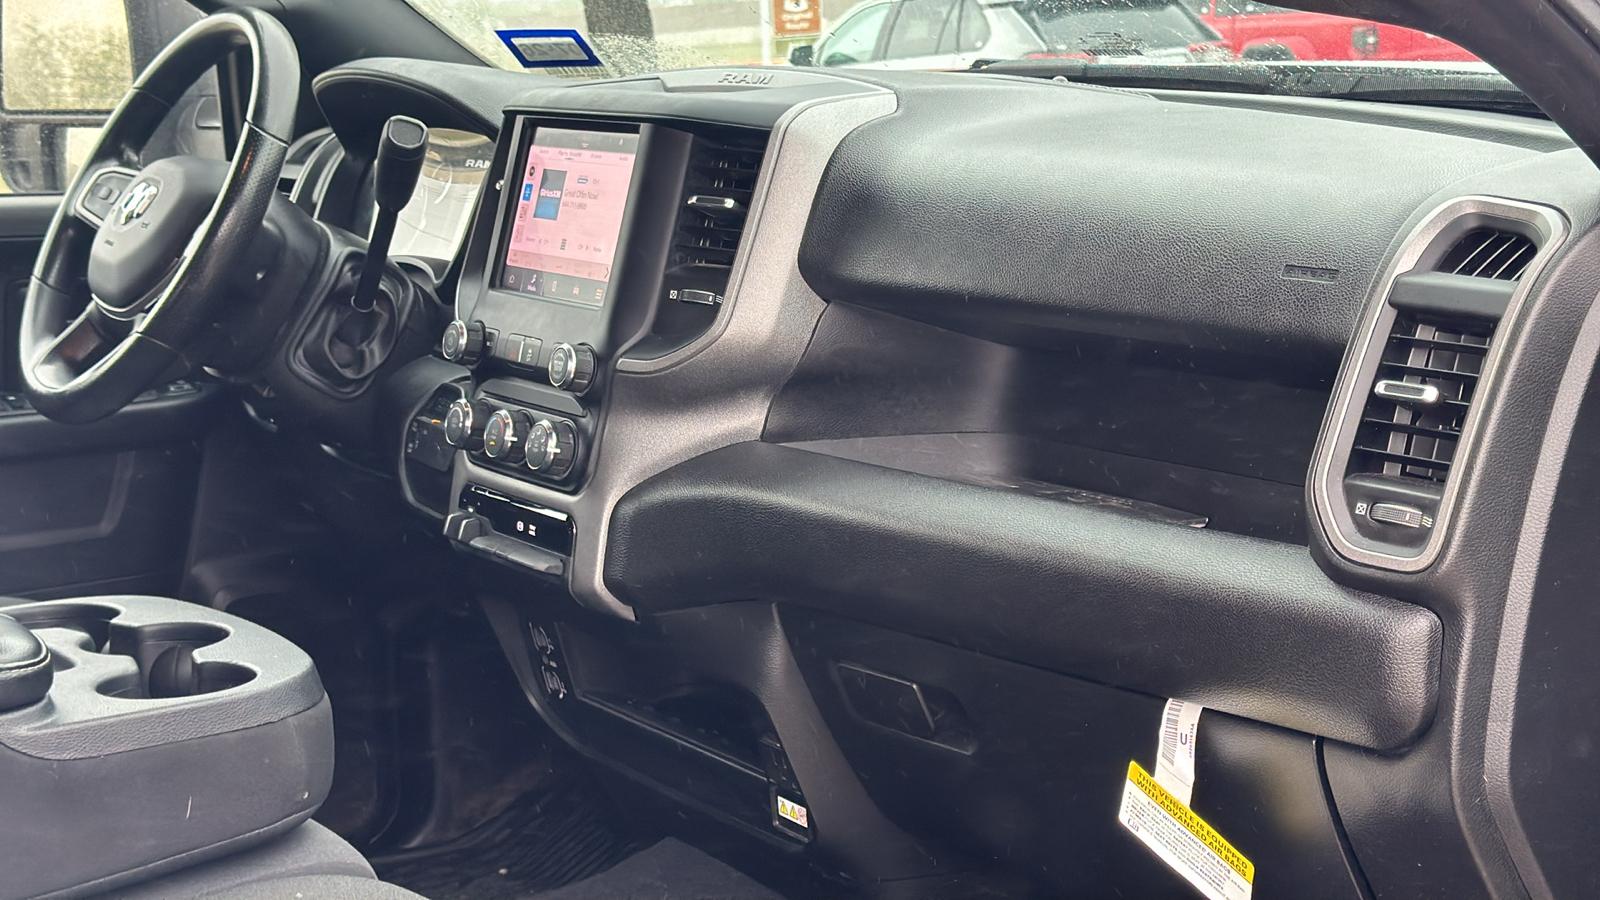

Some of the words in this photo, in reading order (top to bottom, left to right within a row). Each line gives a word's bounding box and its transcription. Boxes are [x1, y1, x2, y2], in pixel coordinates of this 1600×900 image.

[718, 72, 774, 85] RAM
[1180, 732, 1188, 745] U
[1136, 778, 1158, 801] WITH
[1160, 798, 1206, 842] ADVANCED
[1208, 840, 1222, 856] AIR
[1224, 853, 1246, 877] BAGS
[1137, 770, 1157, 792] THIS
[1158, 788, 1194, 824] VEHICLE
[1196, 821, 1204, 832] IS
[1206, 829, 1247, 870] EQUIPPED
